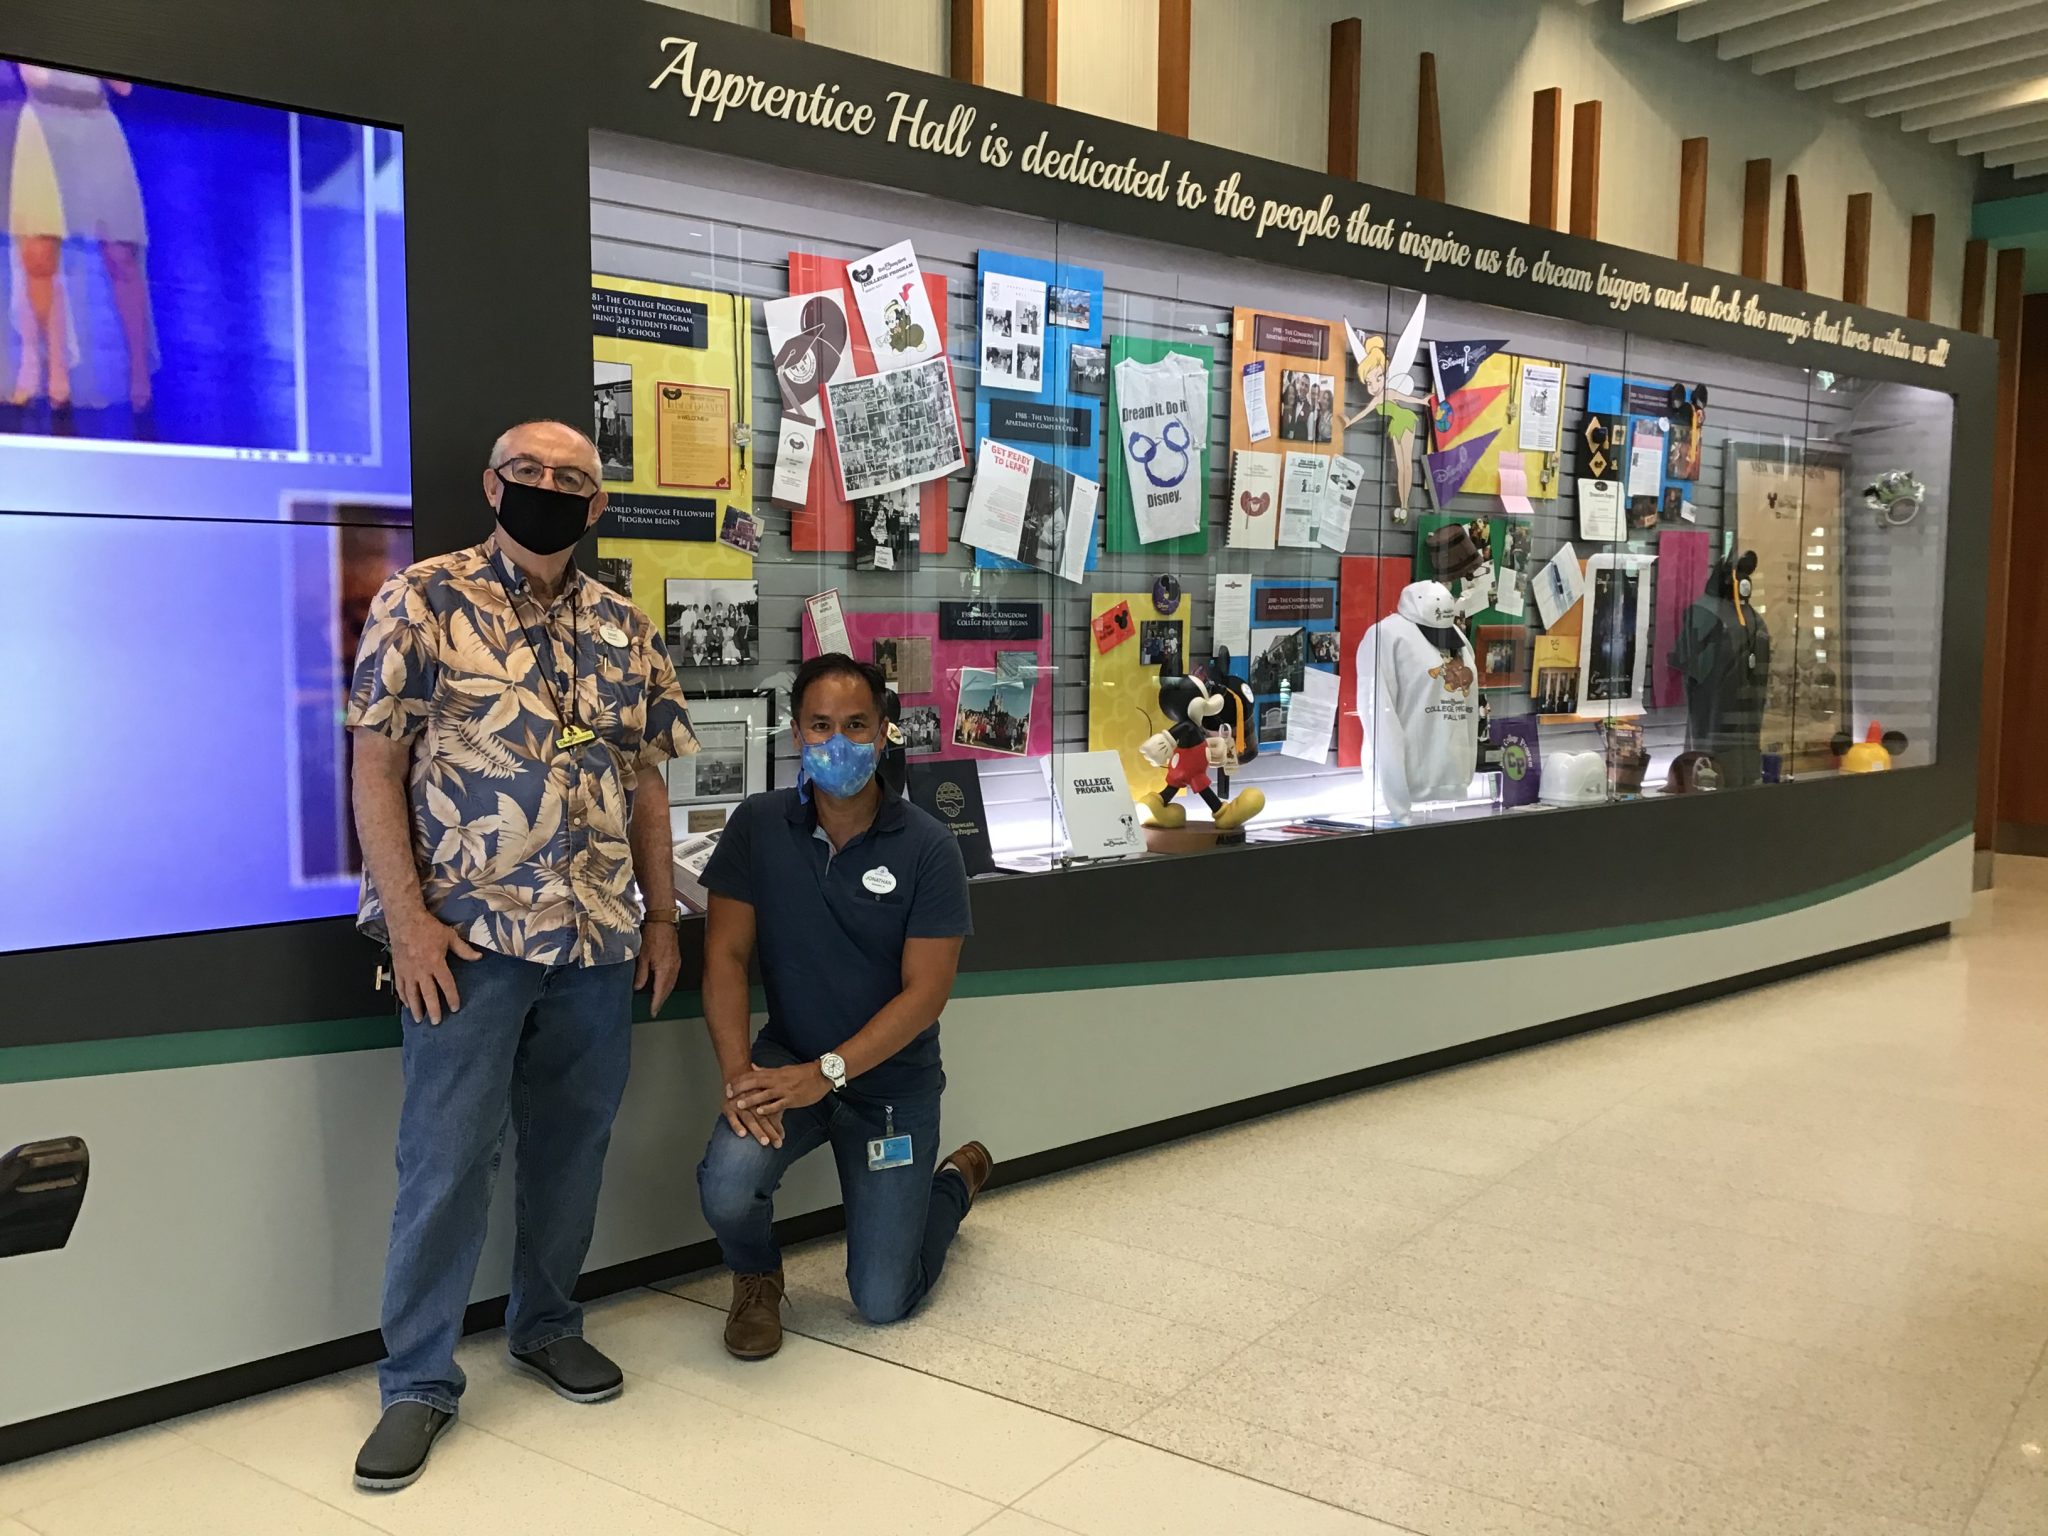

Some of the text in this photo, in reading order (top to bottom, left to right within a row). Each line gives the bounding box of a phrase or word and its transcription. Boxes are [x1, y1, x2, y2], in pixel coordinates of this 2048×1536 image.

[648, 36, 876, 137] Apprentice
[886, 91, 976, 158] Hall
[979, 121, 1013, 169] is
[1020, 130, 1170, 202] dedicated
[1176, 170, 1207, 210] to
[1213, 171, 1256, 222] the
[1256, 194, 1341, 248] people
[1346, 203, 1396, 252] that
[1398, 221, 1472, 273] inspire
[1474, 244, 1504, 275] us
[1506, 246, 1528, 280] to
[1531, 250, 1594, 294] dream
[1597, 263, 1651, 312] bigger
[1654, 281, 1688, 313] and
[1690, 289, 1741, 322] unlock
[1743, 294, 1767, 330] the
[1768, 311, 1811, 345] magic
[1813, 310, 1840, 343] that
[1842, 316, 1871, 352] lives
[1872, 328, 1911, 360] within
[1912, 344, 1927, 364] us
[592, 293, 692, 314] 81- THE COLLEGE PROGRAM
[592, 304, 622, 314] MPLETES
[624, 308, 635, 316] ITS
[637, 309, 657, 319] FIRST
[592, 313, 690, 333] IRING 248 STUDENTS FROM
[616, 326, 661, 338] 43 SCHOOLS
[1122, 405, 1155, 422] Dream
[1166, 400, 1178, 416] Do
[1005, 419, 1036, 429] APARTMENT
[1032, 413, 1042, 421] THE
[1043, 415, 1059, 423] VISTA
[991, 445, 1031, 465] GET READY
[995, 455, 1004, 465] TO
[1147, 489, 1182, 508] Disney.
[604, 505, 715, 518] WORLD SHOWCASE FELLOWSHIP
[617, 516, 680, 526] PROGRAM BEGINS
[1425, 705, 1454, 714] COLLEGE
[1073, 777, 1112, 788] COLLEGE
[1075, 785, 1115, 795] PROGRAM
[865, 875, 892, 886] JONATHAN
